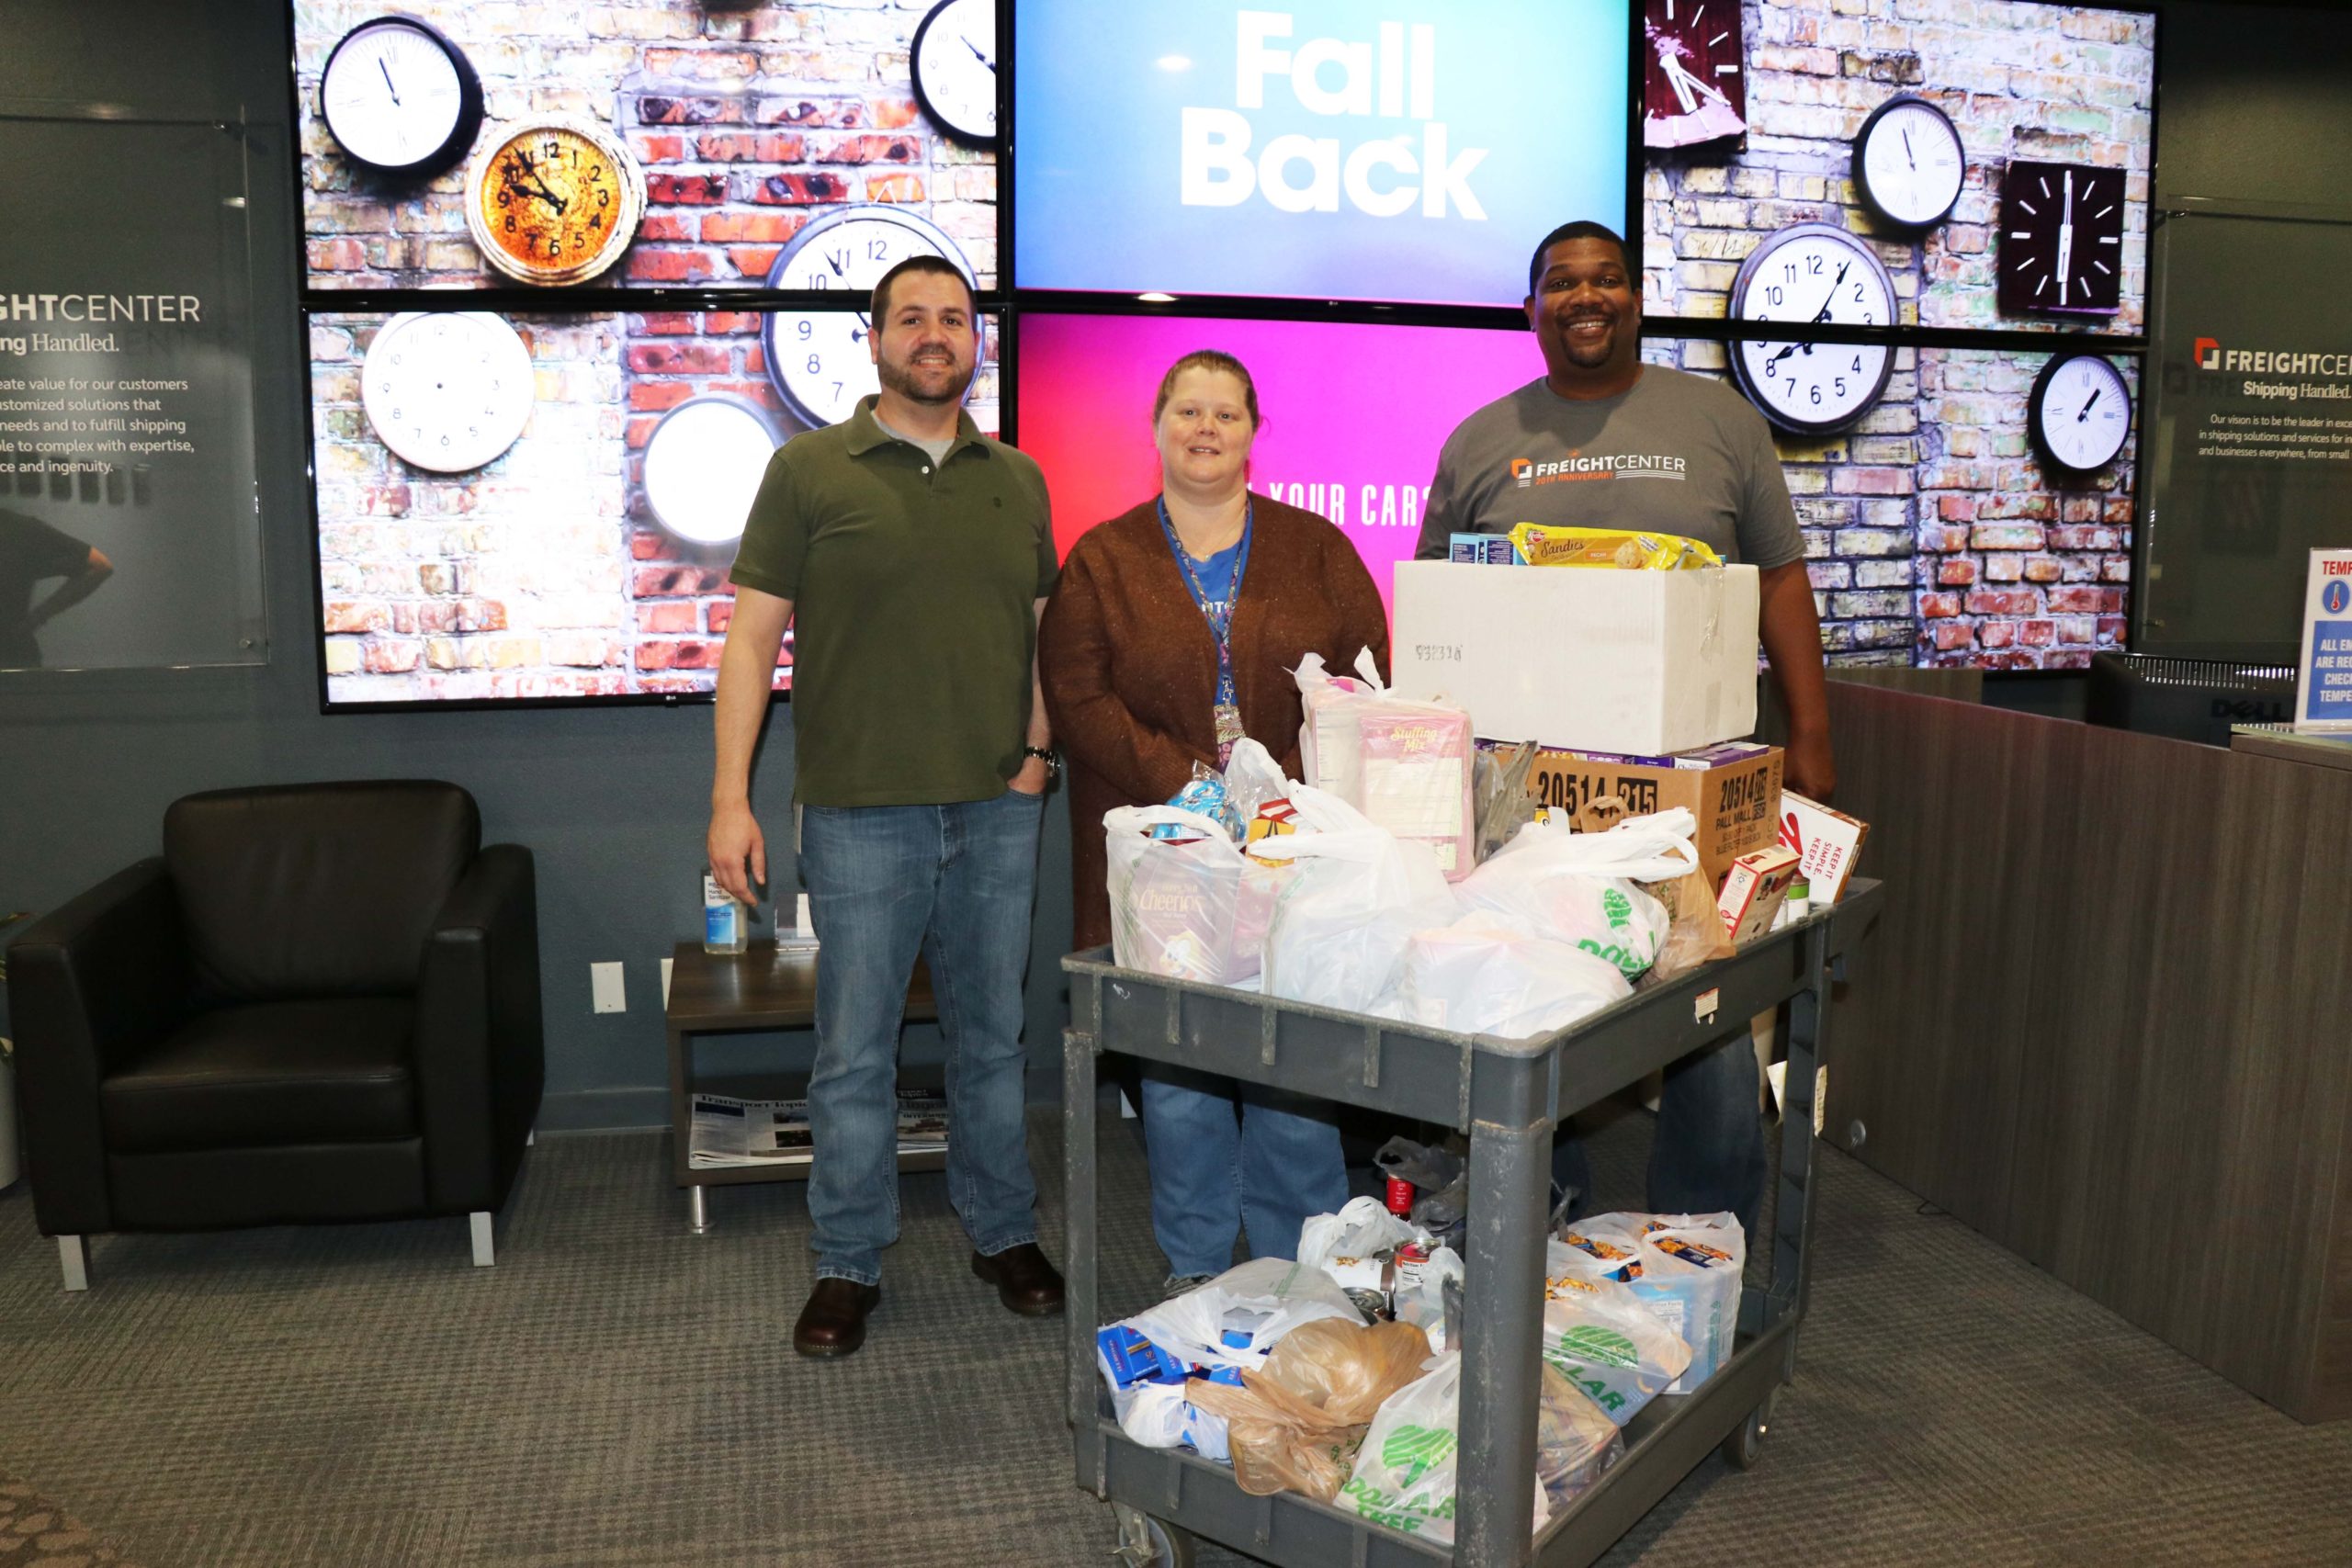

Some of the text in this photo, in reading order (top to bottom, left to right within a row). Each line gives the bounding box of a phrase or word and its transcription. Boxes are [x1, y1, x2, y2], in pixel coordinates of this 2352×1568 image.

[1236, 10, 1435, 119] Fall
[543, 142, 560, 158] 12
[572, 150, 577, 169] 1
[1182, 107, 1489, 220] Back
[590, 165, 602, 182] 2
[497, 192, 510, 209] 9
[598, 188, 609, 207] 3
[505, 215, 516, 233] 8
[589, 213, 602, 230] 4
[526, 232, 537, 251] 7
[549, 239, 560, 256] 6
[574, 231, 585, 249] 5
[836, 248, 851, 269] 11
[867, 240, 888, 261] 12
[1784, 264, 1796, 284] 11
[1806, 255, 1824, 275] 12
[808, 274, 827, 290] 10
[1765, 287, 1782, 306] 10
[1854, 283, 1864, 302] 2
[1862, 313, 1873, 325] 3
[797, 321, 812, 341] 9
[32, 333, 119, 352] Handled.
[807, 354, 820, 374] 8
[1766, 359, 1776, 378] 8
[1851, 355, 1860, 374] 4
[2225, 349, 2352, 376] FREIGHTCE
[29, 378, 66, 390] value
[70, 378, 88, 390] for
[92, 380, 115, 390] our
[119, 378, 188, 390] customers
[831, 382, 844, 402] 7
[1786, 378, 1796, 398] 7
[1835, 378, 1846, 397] 5
[2243, 380, 2352, 400] Shipping Handled.
[1810, 385, 1821, 404] 6
[68, 398, 130, 411] solutions
[133, 398, 162, 411] that
[393, 408, 401, 420] 8
[0, 419, 187, 434] needs and to fulfill shipping
[2211, 413, 2226, 423] Our
[2228, 414, 2252, 425] vision
[2253, 415, 2259, 425] is
[2261, 416, 2270, 425] to
[2271, 415, 2282, 426] be
[2283, 416, 2298, 427] the
[2299, 416, 2324, 428] leader
[2325, 418, 2334, 428] in
[441, 435, 450, 446] 6
[2199, 430, 2207, 439] in
[2208, 430, 2242, 443] shipping
[2244, 432, 2280, 442] solutions
[2281, 432, 2298, 443] and
[2298, 434, 2330, 444] services
[2331, 434, 2344, 444] for
[0, 439, 195, 455] le to complex with expertise,
[2199, 446, 2350, 460] and businesses everywhere, from small
[18, 459, 45, 472] and
[48, 459, 114, 476] ingenuity.
[1536, 455, 1686, 478] FREIGHTCENTER
[1535, 470, 1614, 486] 20TH ANNIVERSARY
[1541, 539, 1585, 558] Sandies
[2321, 639, 2337, 651] ALL
[2315, 656, 2335, 668] ARE
[2211, 698, 2288, 724] DELL
[1720, 773, 1755, 813] 20514
[1804, 838, 1821, 871] KEEP IT
[1826, 846, 1843, 880] KEEP IT
